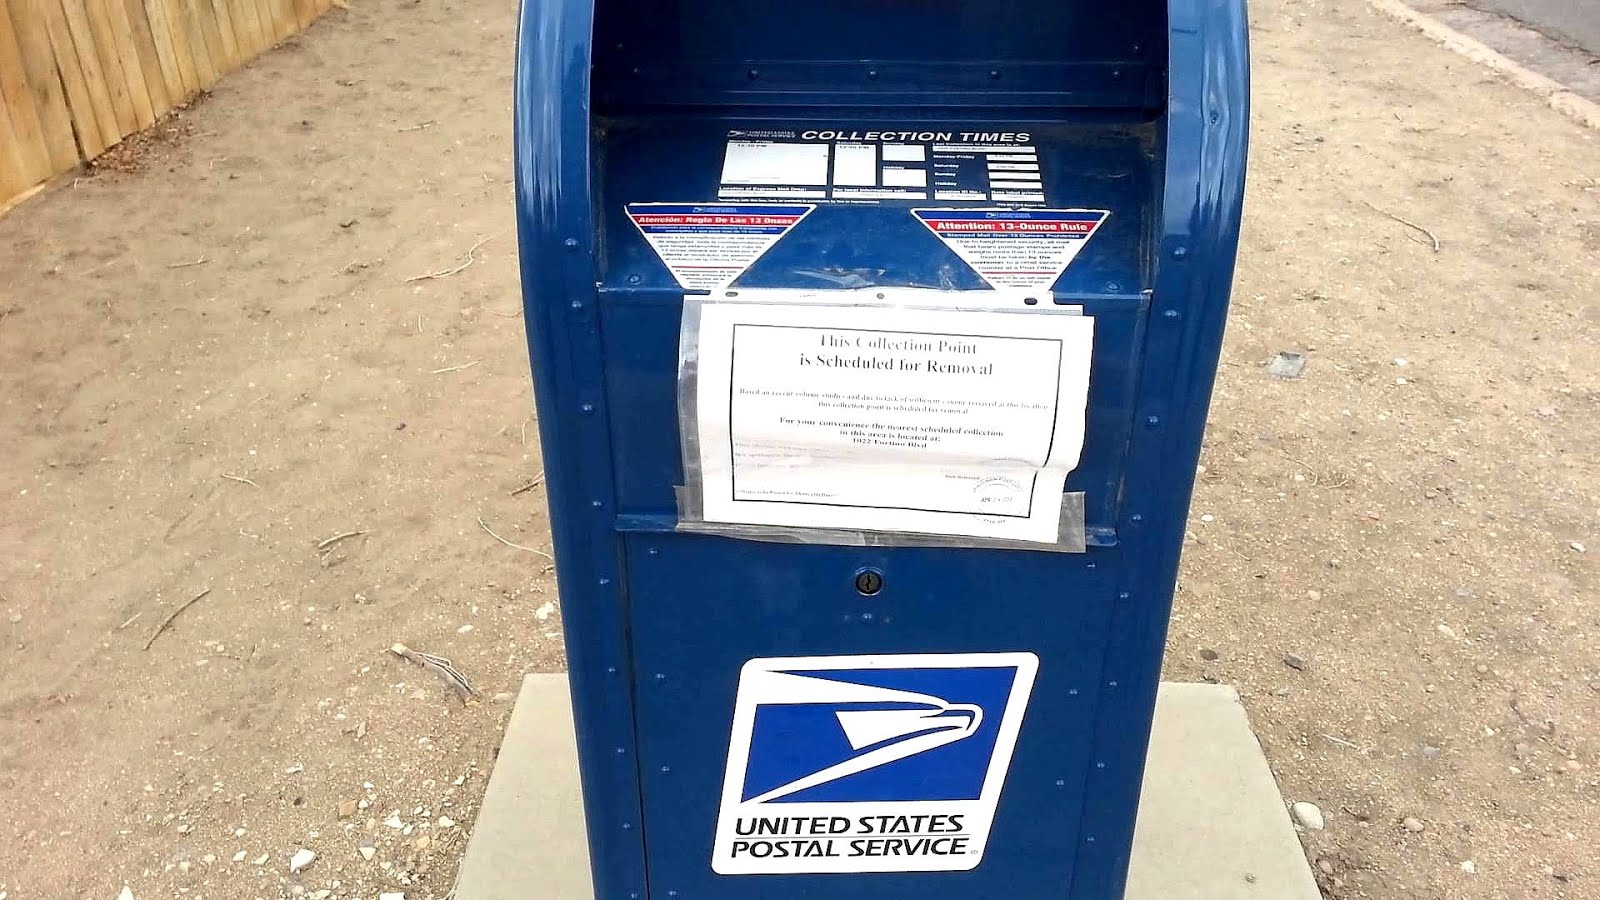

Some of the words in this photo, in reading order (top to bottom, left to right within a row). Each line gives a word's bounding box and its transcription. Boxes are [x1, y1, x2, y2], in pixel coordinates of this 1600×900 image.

[801, 130, 952, 141] COLLECTION
[960, 132, 1031, 142] TIMES
[1000, 223, 1057, 231] 13-Ounce
[1060, 223, 1088, 231] Rule
[821, 333, 850, 348] This
[855, 336, 932, 351] Collection
[938, 340, 976, 354] Point
[800, 353, 812, 366] is
[816, 354, 894, 371] Scheduled
[899, 358, 923, 371] for
[926, 359, 993, 375] Removal
[780, 416, 796, 424] For
[797, 419, 816, 427] your
[819, 420, 870, 429] convenience
[887, 424, 918, 432] nearest
[920, 426, 961, 435] scheduled
[963, 428, 1004, 437] collection
[897, 433, 928, 441] located
[735, 816, 851, 836] UNITED
[857, 814, 964, 834] STATES
[731, 839, 840, 858] POSTAL
[848, 837, 970, 857] SERVICE
